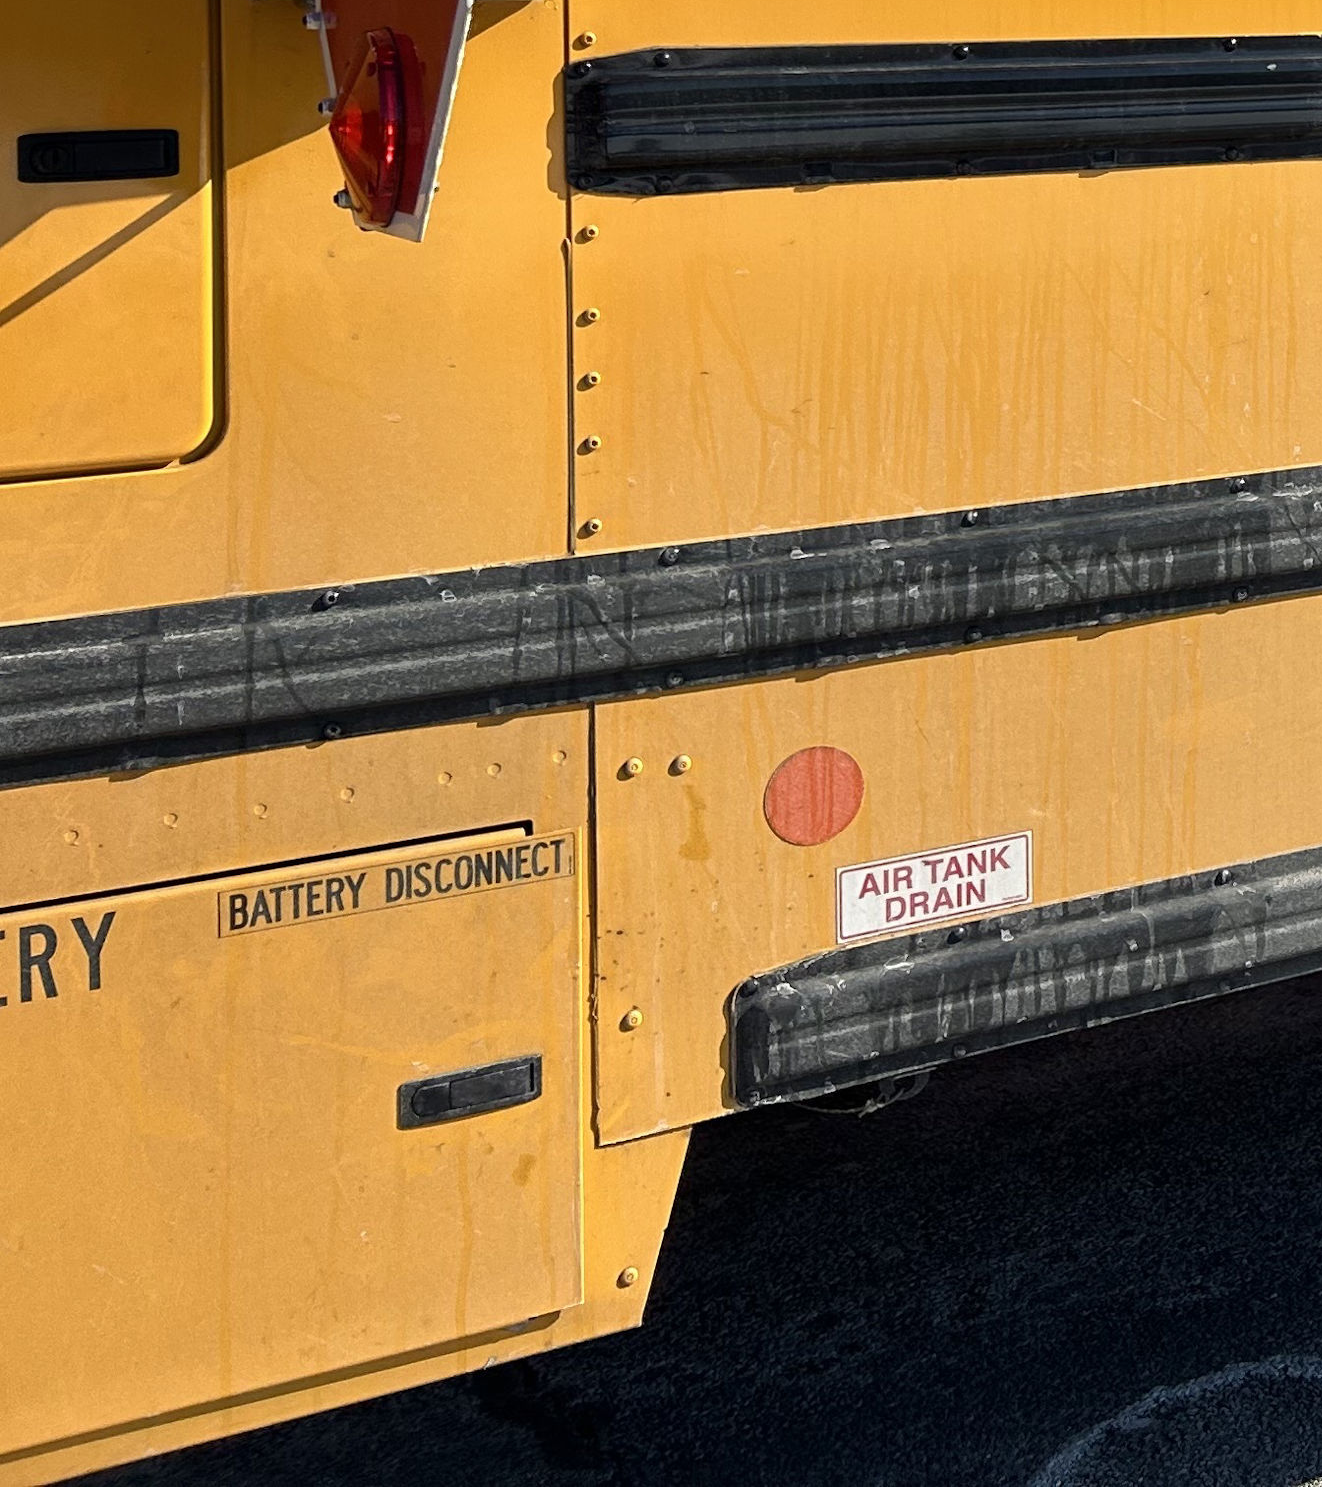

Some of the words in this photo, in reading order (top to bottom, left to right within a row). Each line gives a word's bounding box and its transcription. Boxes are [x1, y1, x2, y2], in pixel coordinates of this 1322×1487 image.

[228, 872, 367, 931] BATTERY
[385, 838, 566, 904] DISCONNECT
[858, 865, 913, 899] AIR
[921, 845, 1011, 885] TANK
[885, 879, 986, 923] DRAIN
[0, 911, 117, 1008] RY
